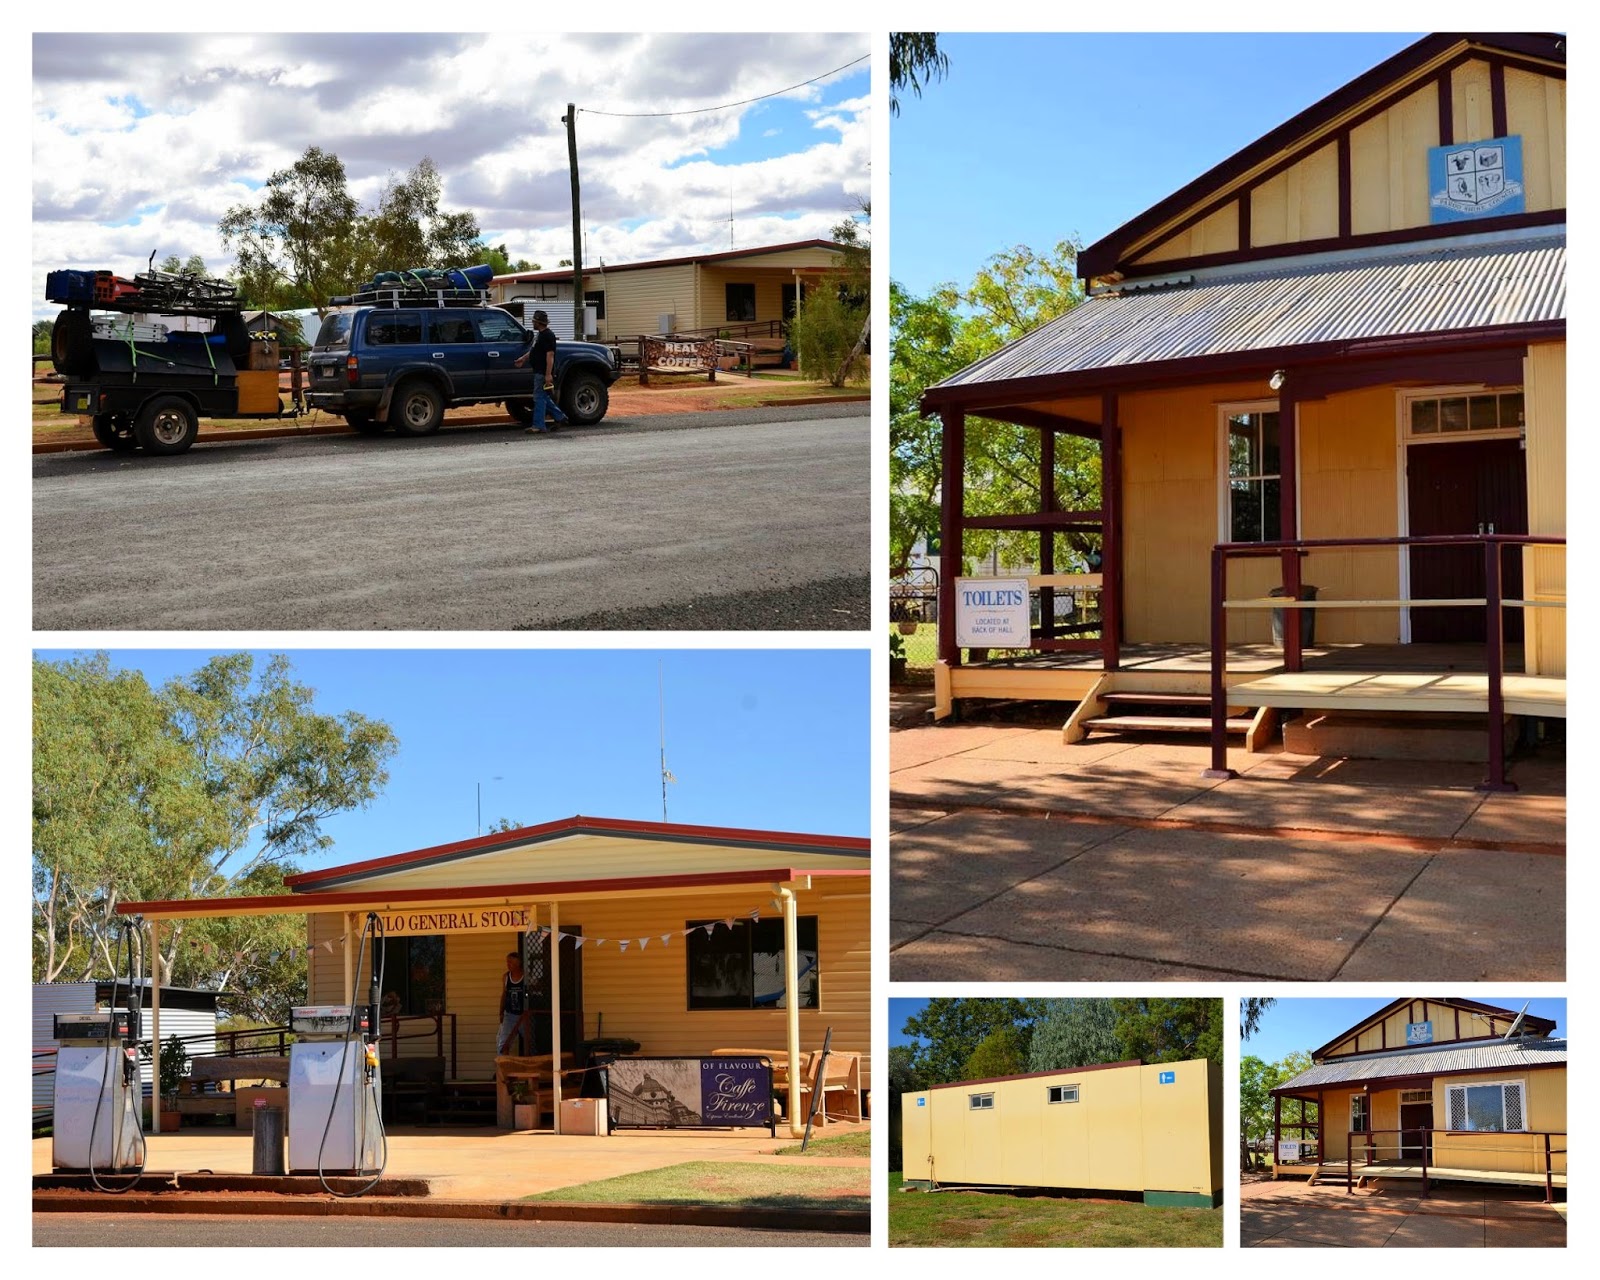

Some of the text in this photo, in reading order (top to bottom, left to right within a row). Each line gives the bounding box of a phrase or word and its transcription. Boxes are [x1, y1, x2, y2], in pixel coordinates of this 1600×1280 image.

[664, 343, 698, 352] REAL
[657, 357, 703, 367] COFFEE
[962, 590, 1023, 606] TOILETS
[408, 912, 478, 930] GENERAL
[702, 1062, 714, 1070] OF
[719, 1062, 762, 1070] FLAVOUR
[706, 1092, 765, 1119] Firenze
